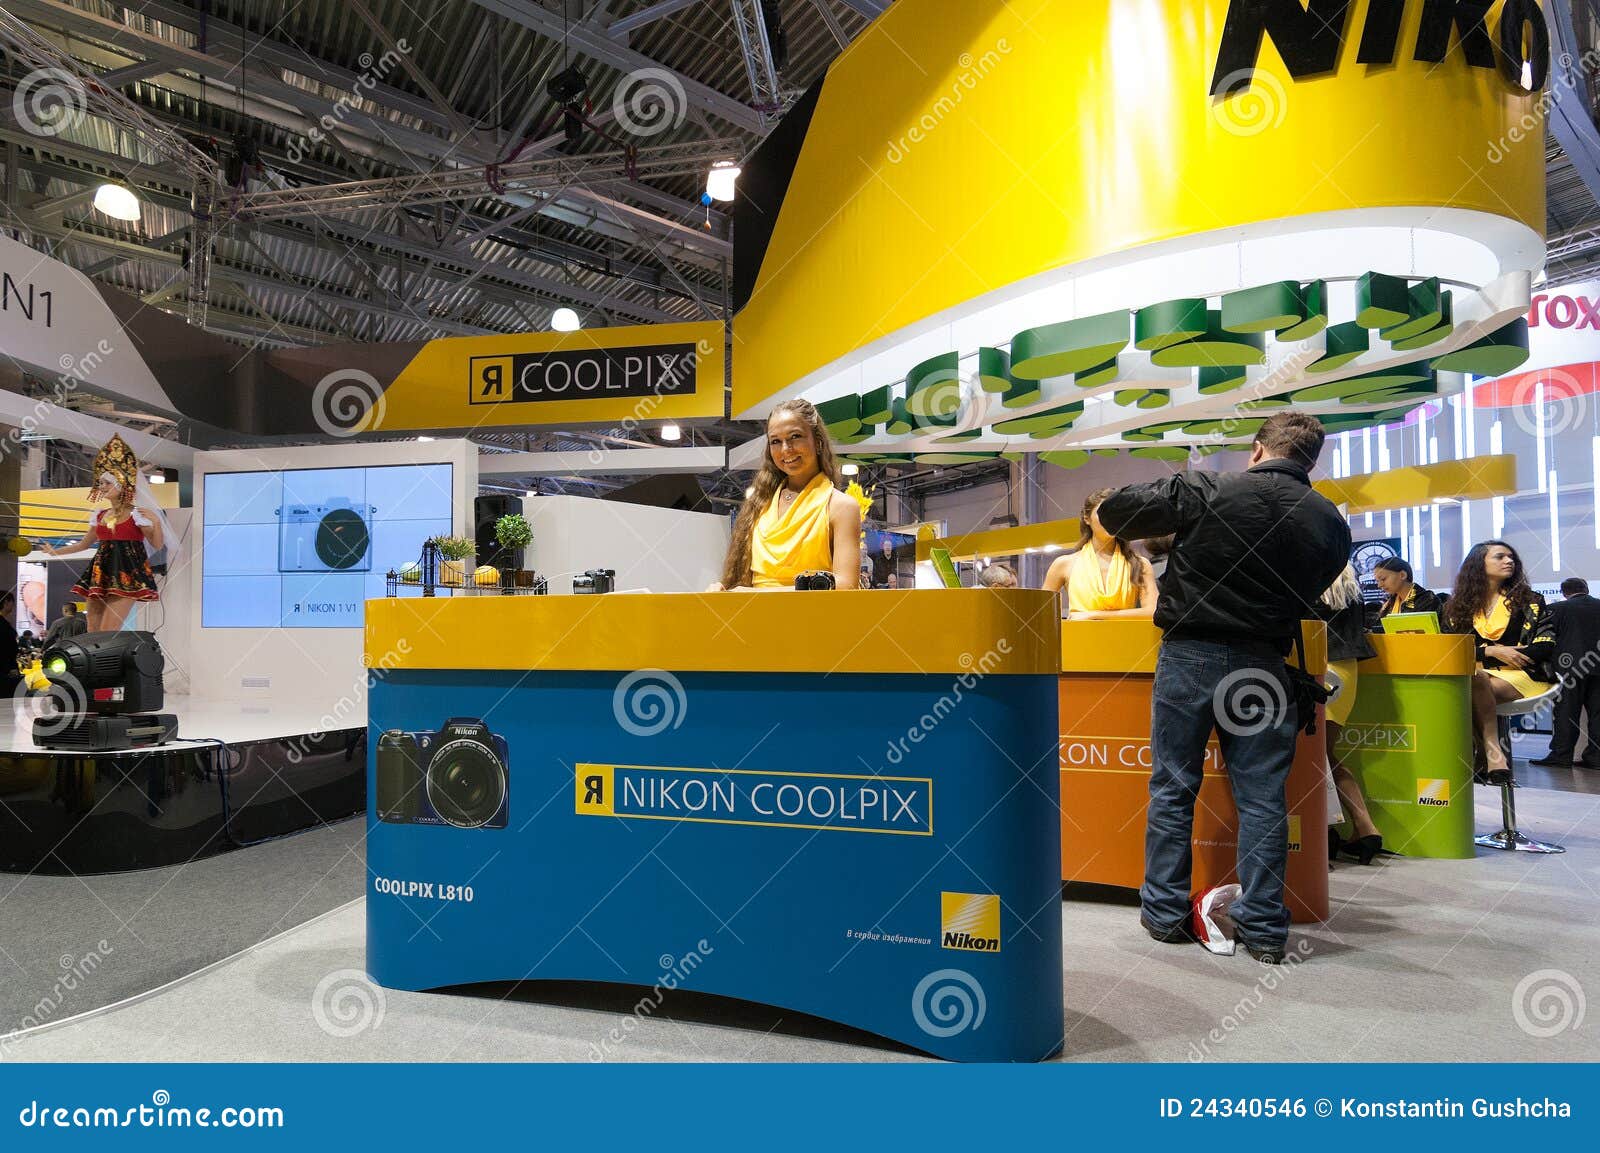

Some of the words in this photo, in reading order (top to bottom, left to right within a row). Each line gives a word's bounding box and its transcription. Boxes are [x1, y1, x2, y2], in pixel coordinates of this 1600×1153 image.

[521, 354, 681, 394] COOLPIX
[307, 603, 336, 613] NIKON
[346, 603, 357, 612] V1
[454, 727, 478, 736] Nikon
[622, 776, 736, 813] NIKON
[751, 783, 919, 823] COOLPIX
[1418, 797, 1449, 806] Nikon
[375, 877, 434, 899] COOLPIX
[438, 884, 474, 902] L810
[846, 930, 852, 938] В
[854, 931, 880, 941] сердце
[882, 933, 931, 945] изображения
[943, 932, 999, 951] Nikon
